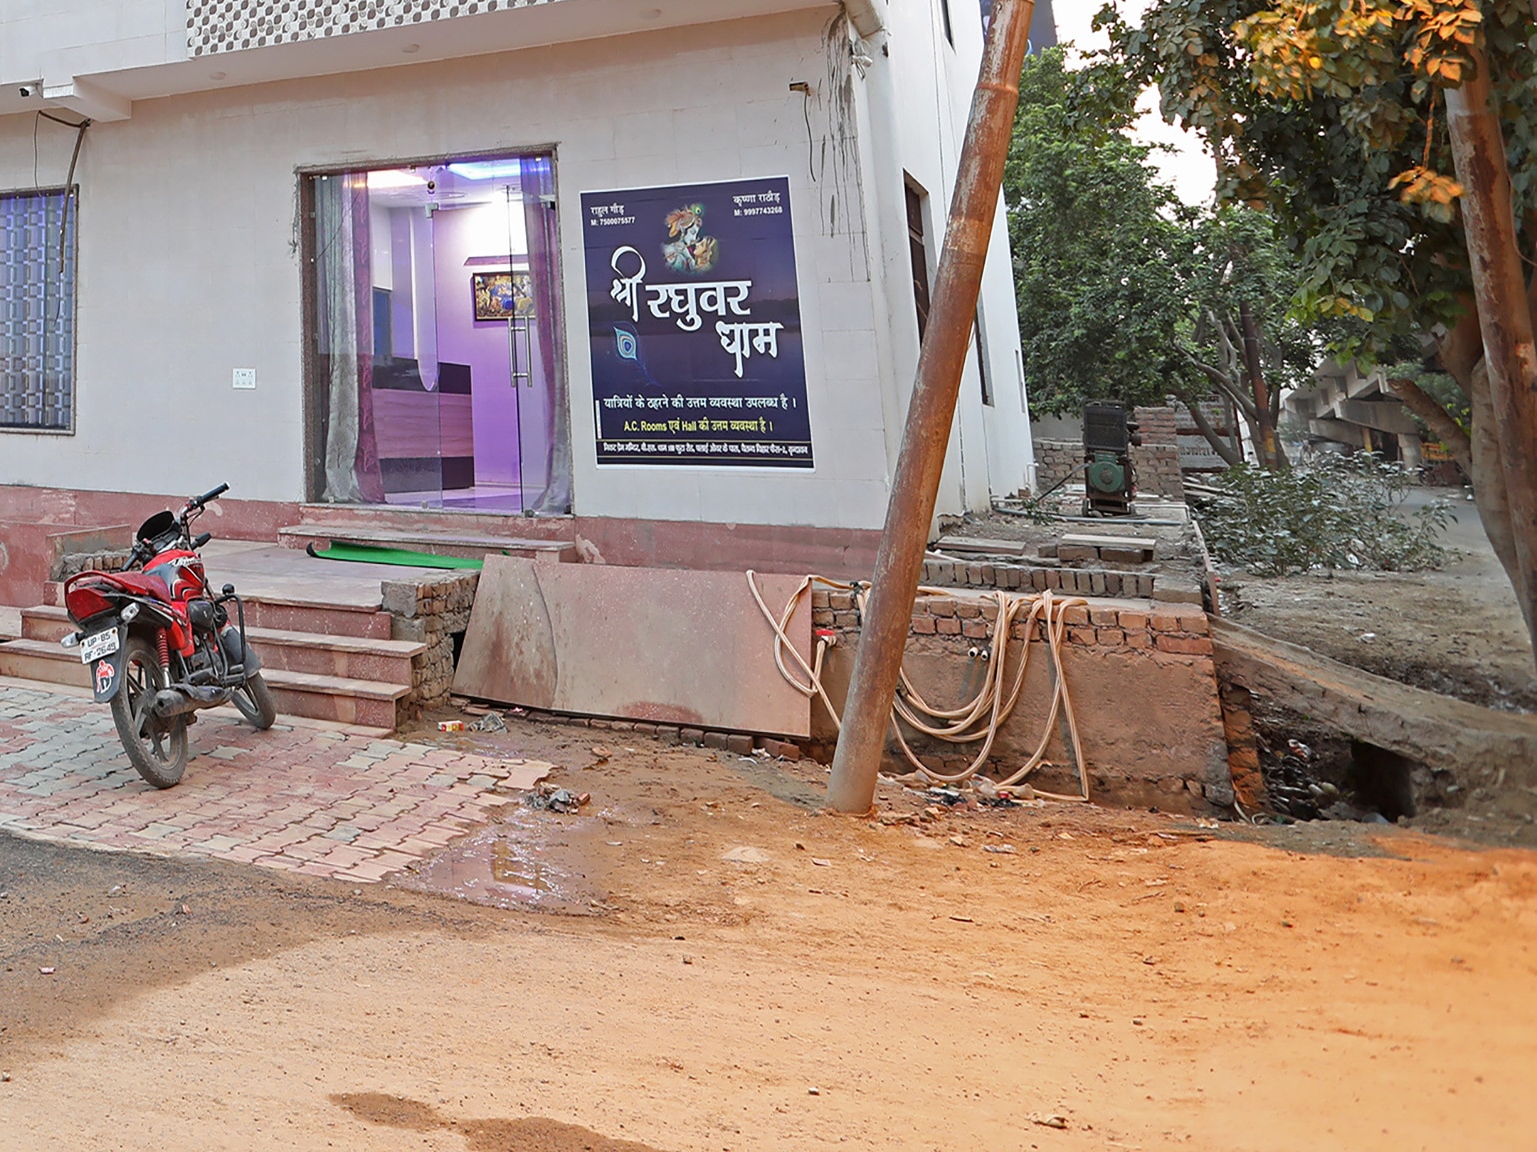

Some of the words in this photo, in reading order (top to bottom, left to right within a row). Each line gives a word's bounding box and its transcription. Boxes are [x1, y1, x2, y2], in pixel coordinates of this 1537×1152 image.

[610, 245, 647, 323] श्री
[645, 280, 752, 332] रघुवर
[715, 320, 783, 378] धाम
[603, 394, 633, 408] यात्रियों
[634, 394, 645, 408] के
[646, 394, 669, 410] ठहरने
[671, 394, 684, 408] की
[686, 397, 707, 408] उत्तम
[709, 397, 743, 409] व्यवस्था
[744, 397, 778, 408] उपलब्ध
[780, 393, 788, 410] है
[624, 420, 640, 431] A.C.
[641, 421, 668, 432] Rooms
[668, 417, 680, 435] एवं
[682, 421, 697, 431] Hall
[698, 416, 709, 431] की
[711, 420, 728, 431] उत्तम
[730, 420, 758, 432] व्यवस्था
[759, 416, 766, 433] है
